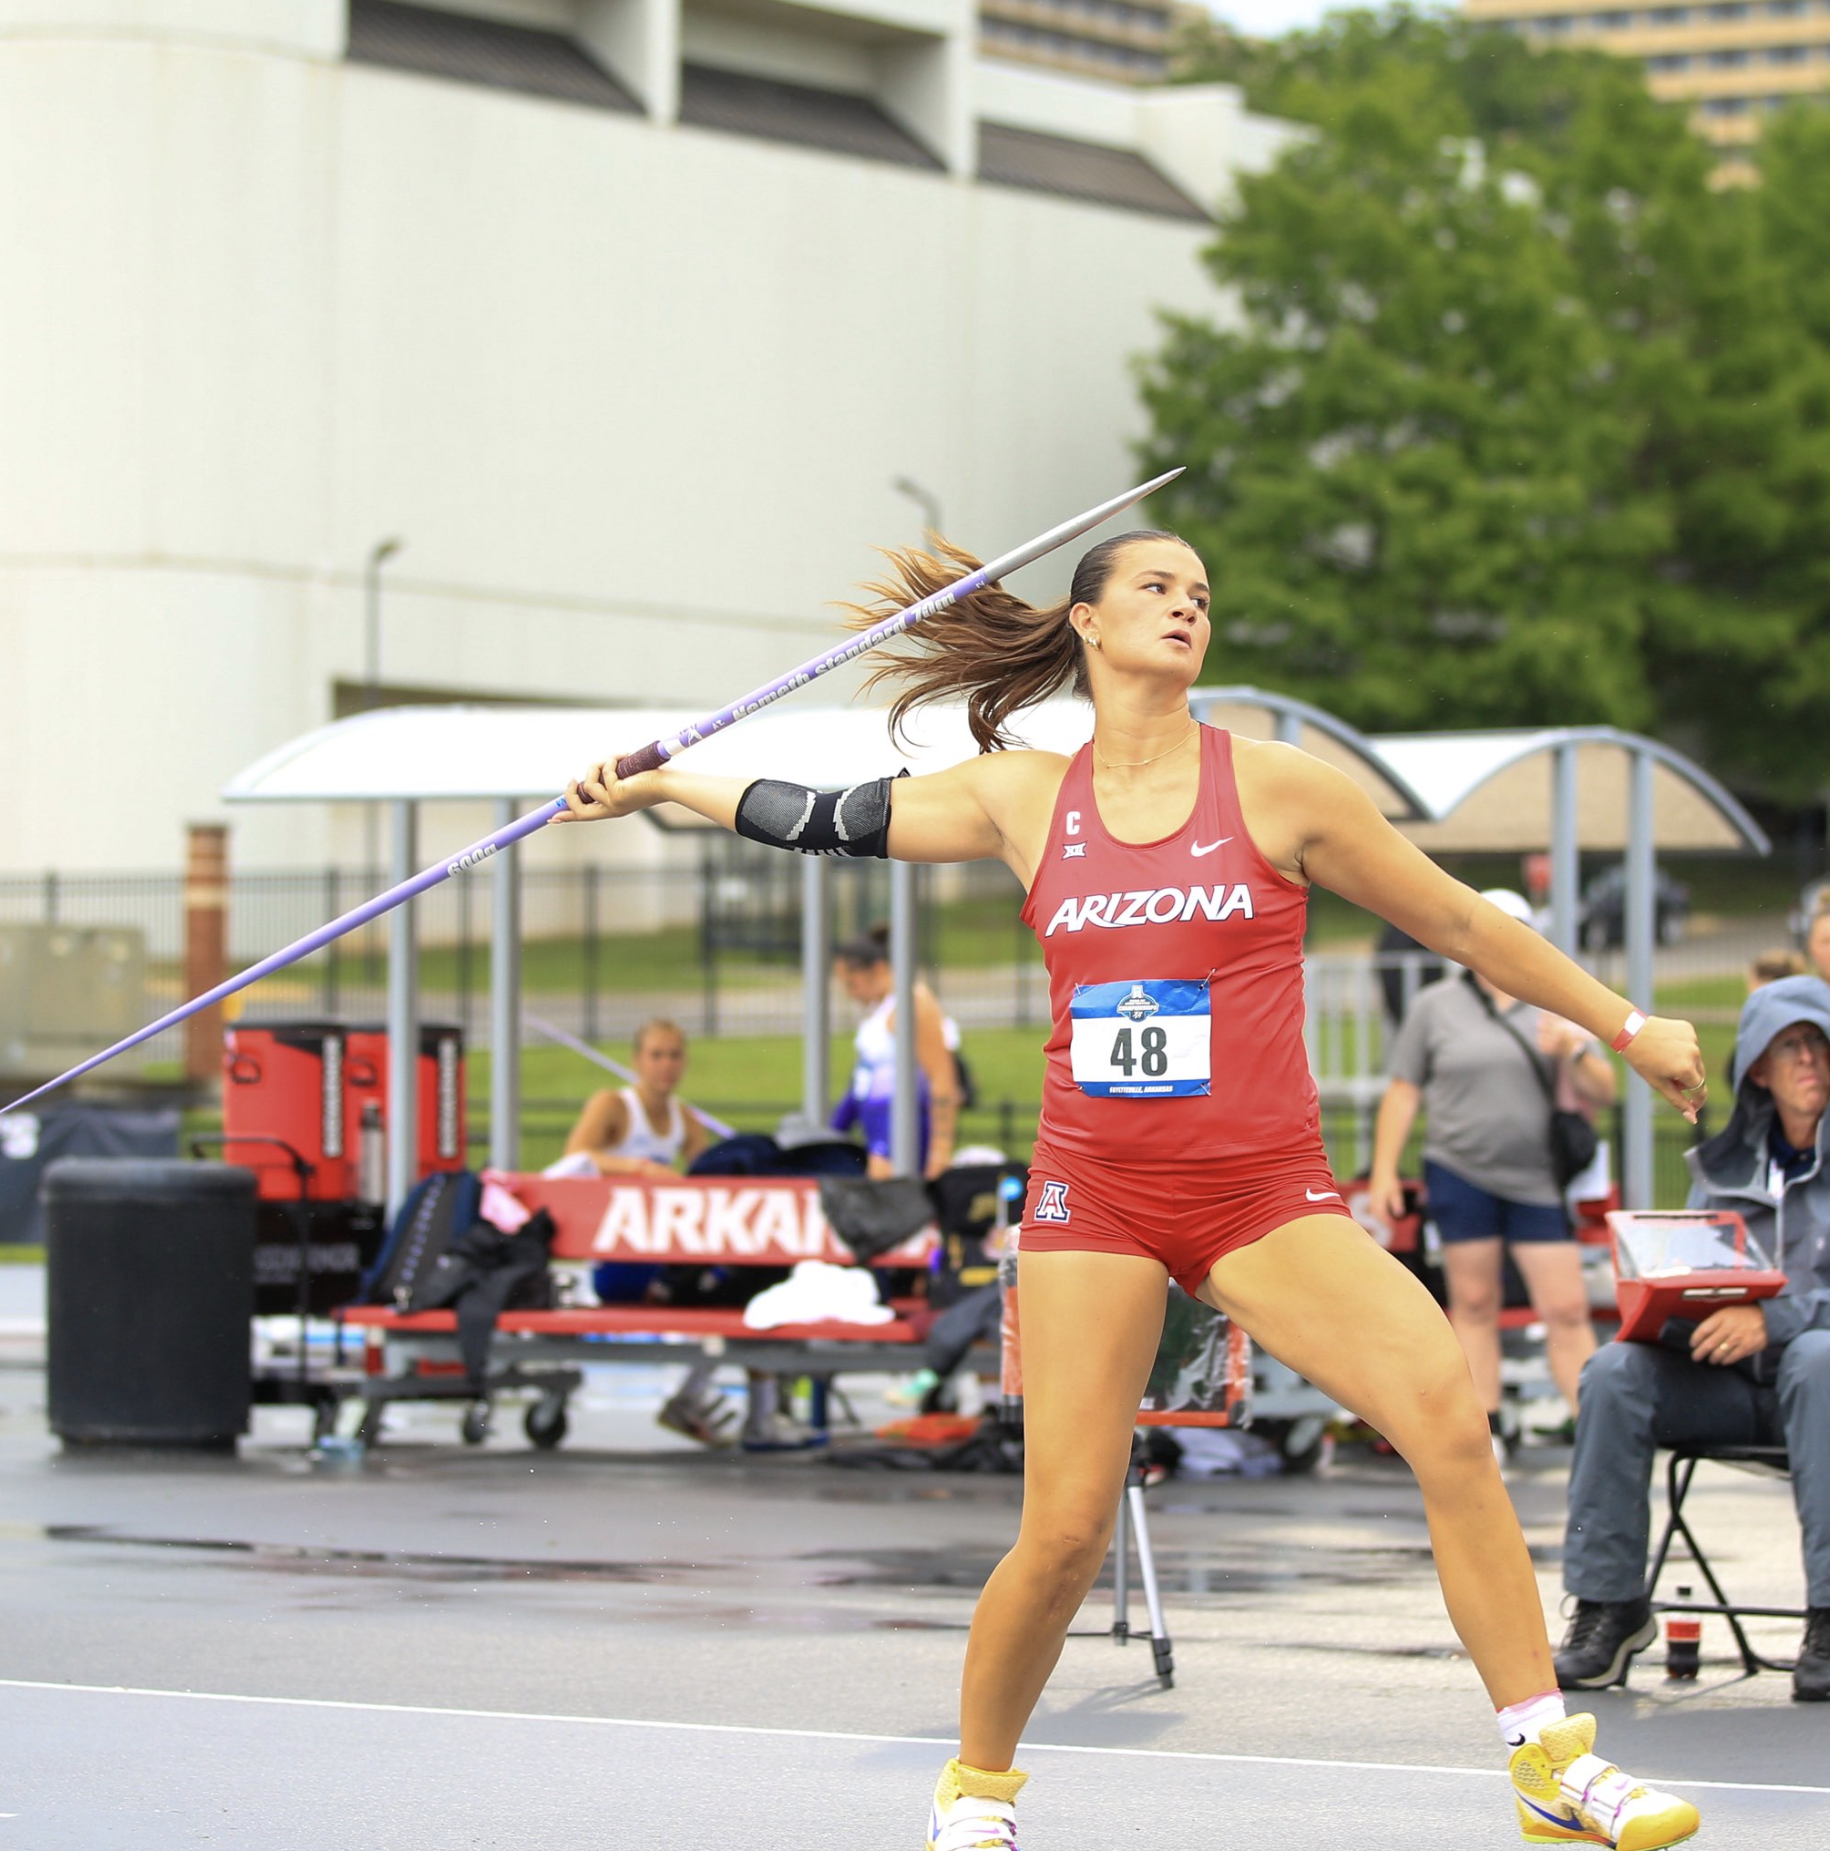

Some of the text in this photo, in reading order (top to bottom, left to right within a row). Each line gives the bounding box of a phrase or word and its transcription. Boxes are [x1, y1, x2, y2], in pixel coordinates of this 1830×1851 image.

[731, 591, 957, 722] Nemeth standard 70m
[1066, 810, 1081, 836] C
[1044, 882, 1255, 938] ARIZONA
[1110, 1026, 1168, 1077] 48
[1034, 1180, 1071, 1224] A
